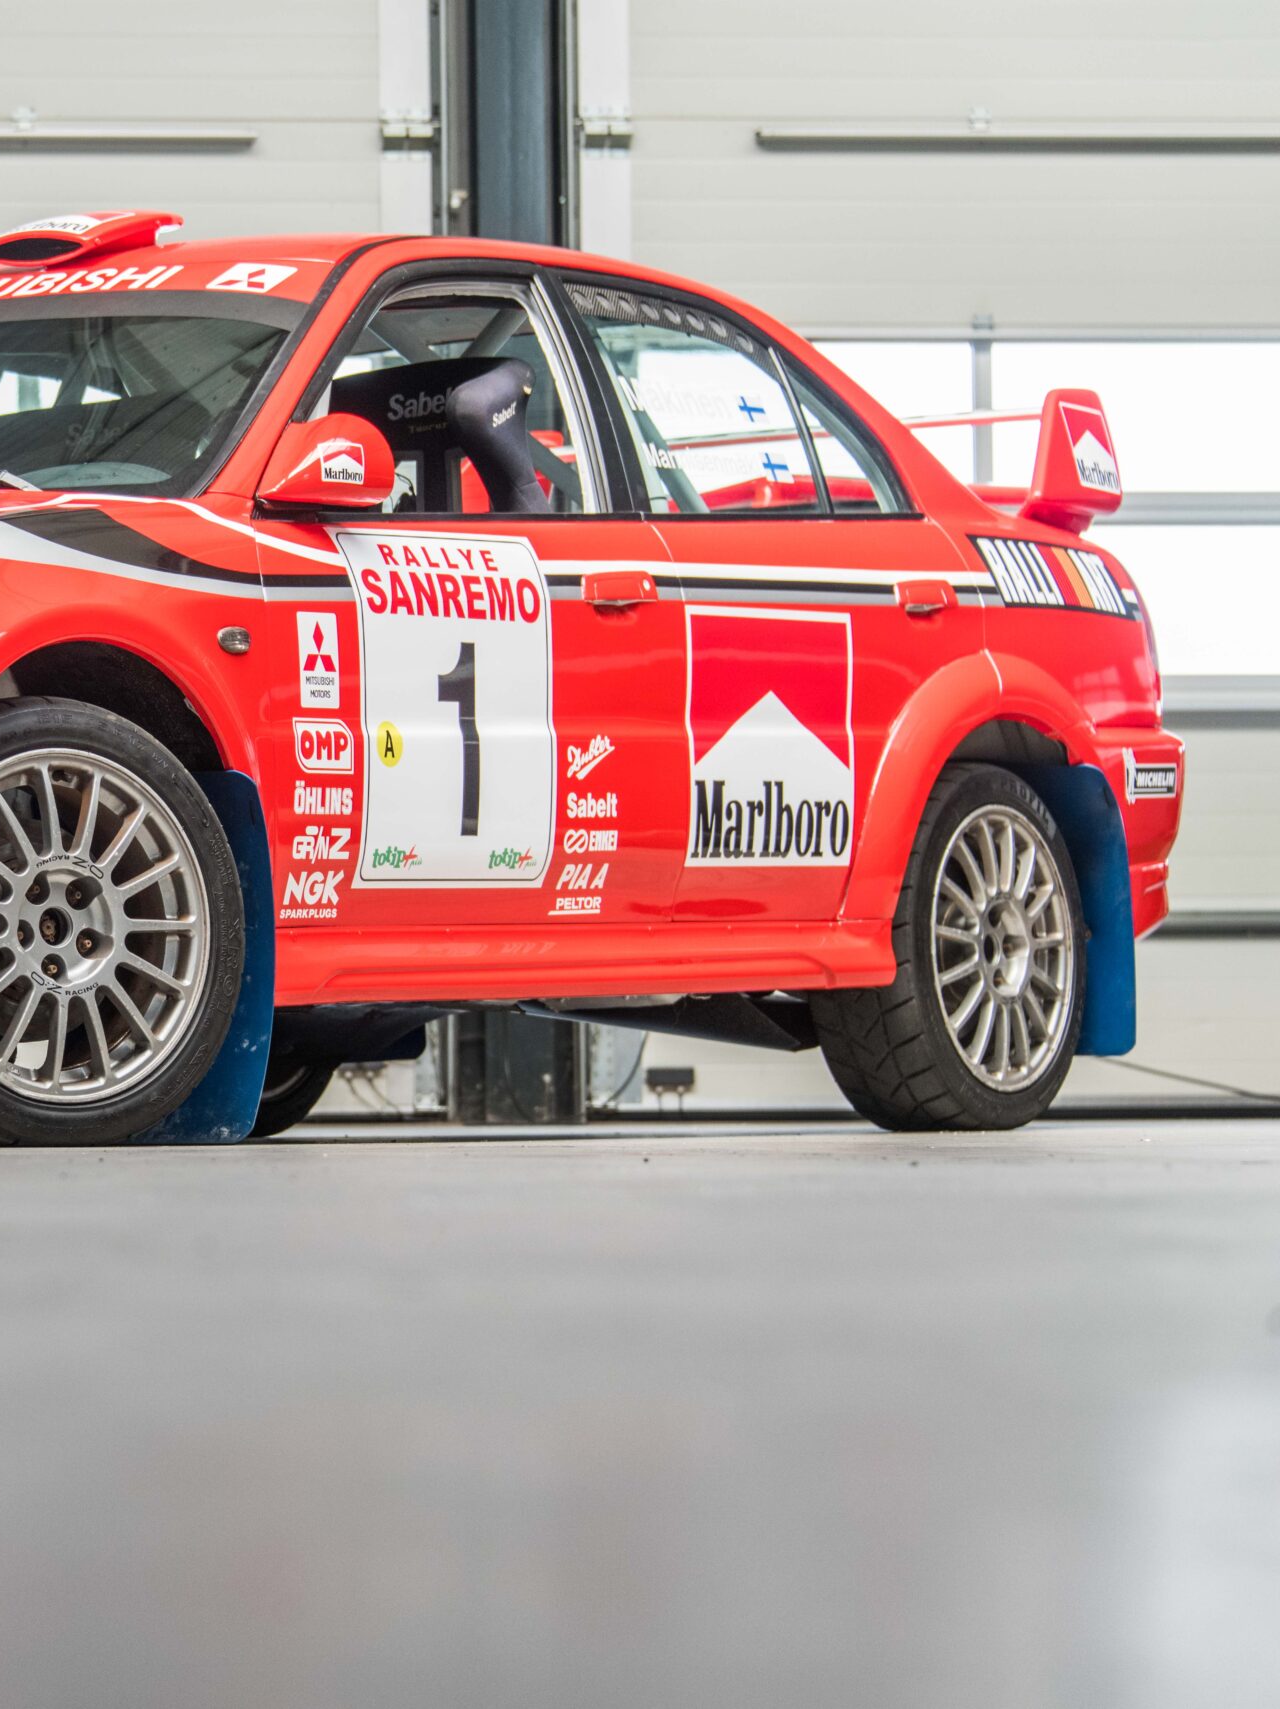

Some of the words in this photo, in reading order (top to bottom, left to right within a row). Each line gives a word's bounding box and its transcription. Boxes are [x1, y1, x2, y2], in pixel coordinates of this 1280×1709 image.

[324, 466, 363, 482] Marlboro
[1076, 458, 1120, 489] Marlboro
[376, 543, 499, 572] RALLYE
[360, 568, 541, 624] SANREMO
[305, 675, 335, 686] MITSUBISHI
[310, 689, 331, 699] MOTORS
[300, 729, 348, 761] OMP
[384, 729, 395, 758] A
[437, 641, 481, 837] 1
[1137, 771, 1175, 787] MICHELIN
[293, 780, 353, 815] ÖHLINS
[566, 792, 618, 819] Sabelt
[690, 780, 850, 859] Marlboro
[282, 869, 345, 906] NGK
[556, 896, 601, 910] PELTOR
[65, 982, 99, 996] RACING
